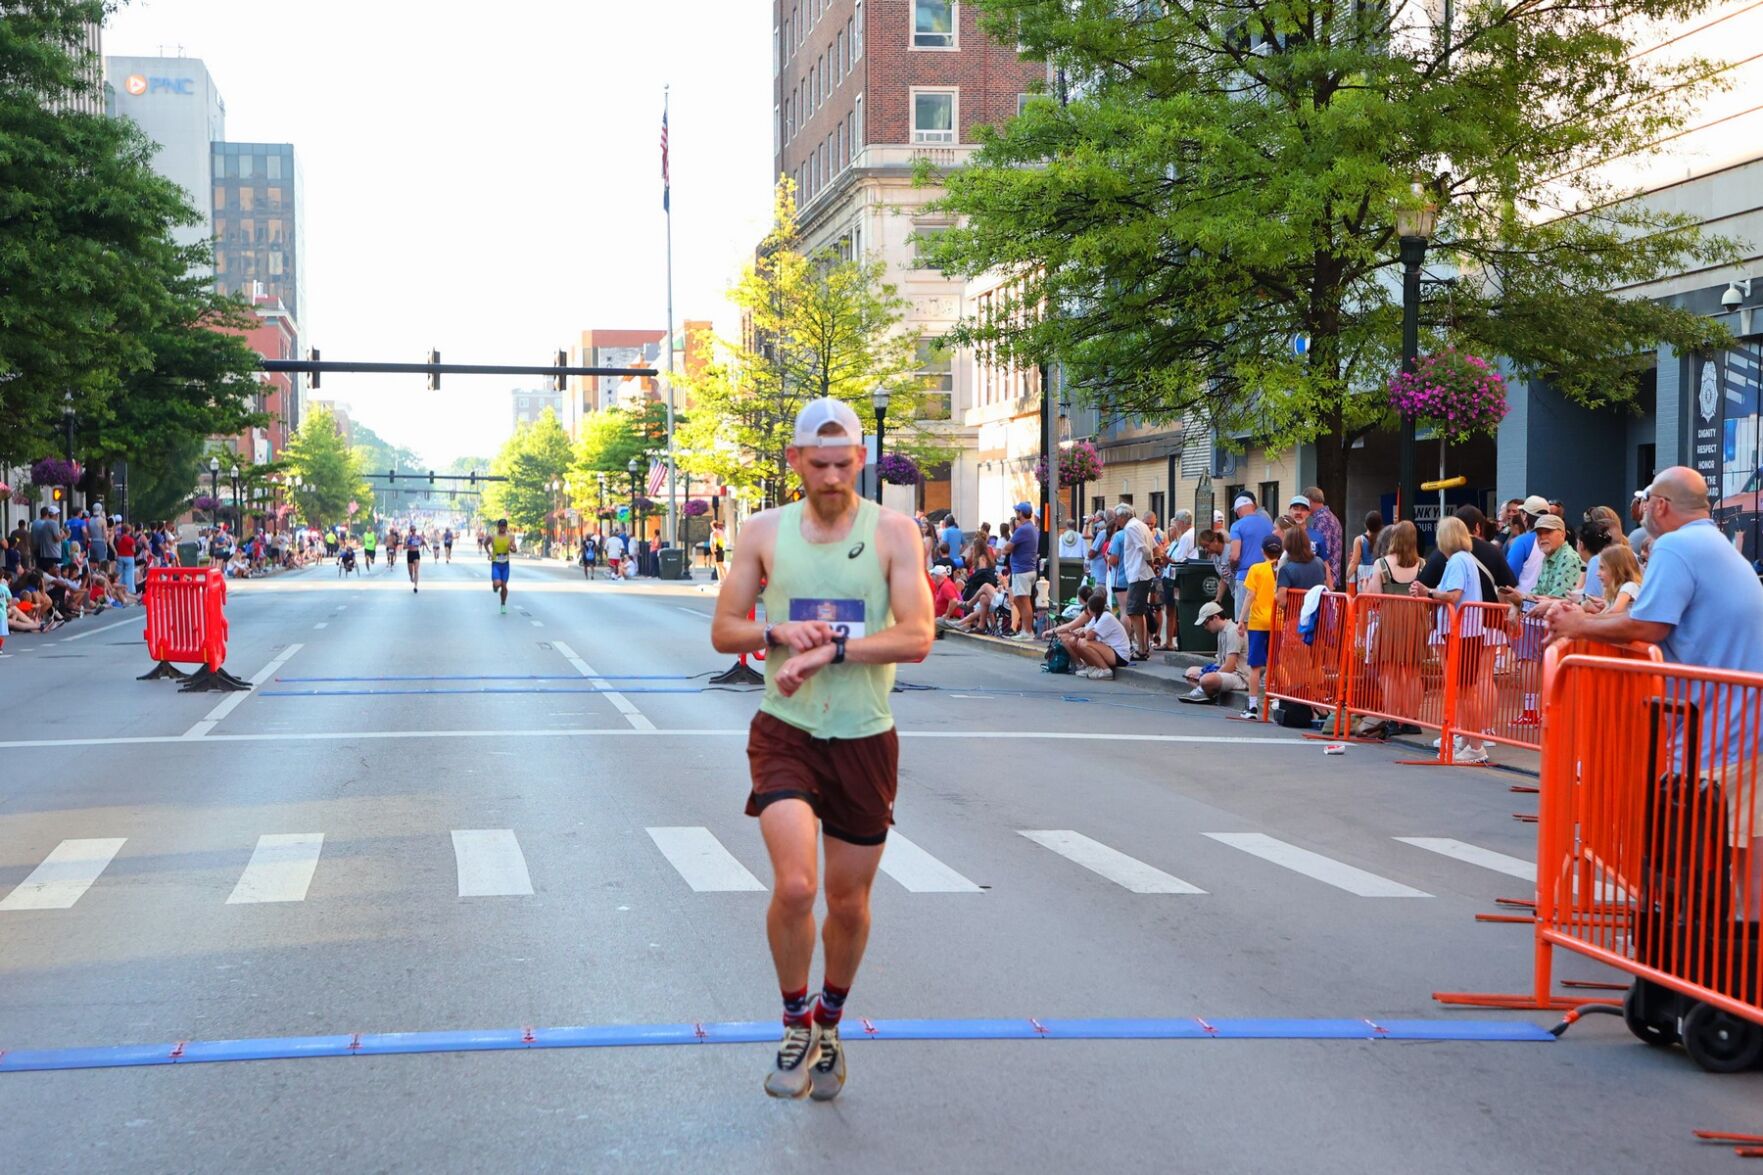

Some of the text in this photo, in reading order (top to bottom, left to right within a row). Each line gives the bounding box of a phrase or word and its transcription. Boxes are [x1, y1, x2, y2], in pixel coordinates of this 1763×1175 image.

[149, 76, 194, 95] PNC
[1698, 428, 1717, 439] DIGNITY
[1697, 444, 1717, 455] RESPECT
[1698, 460, 1715, 470] HONOR
